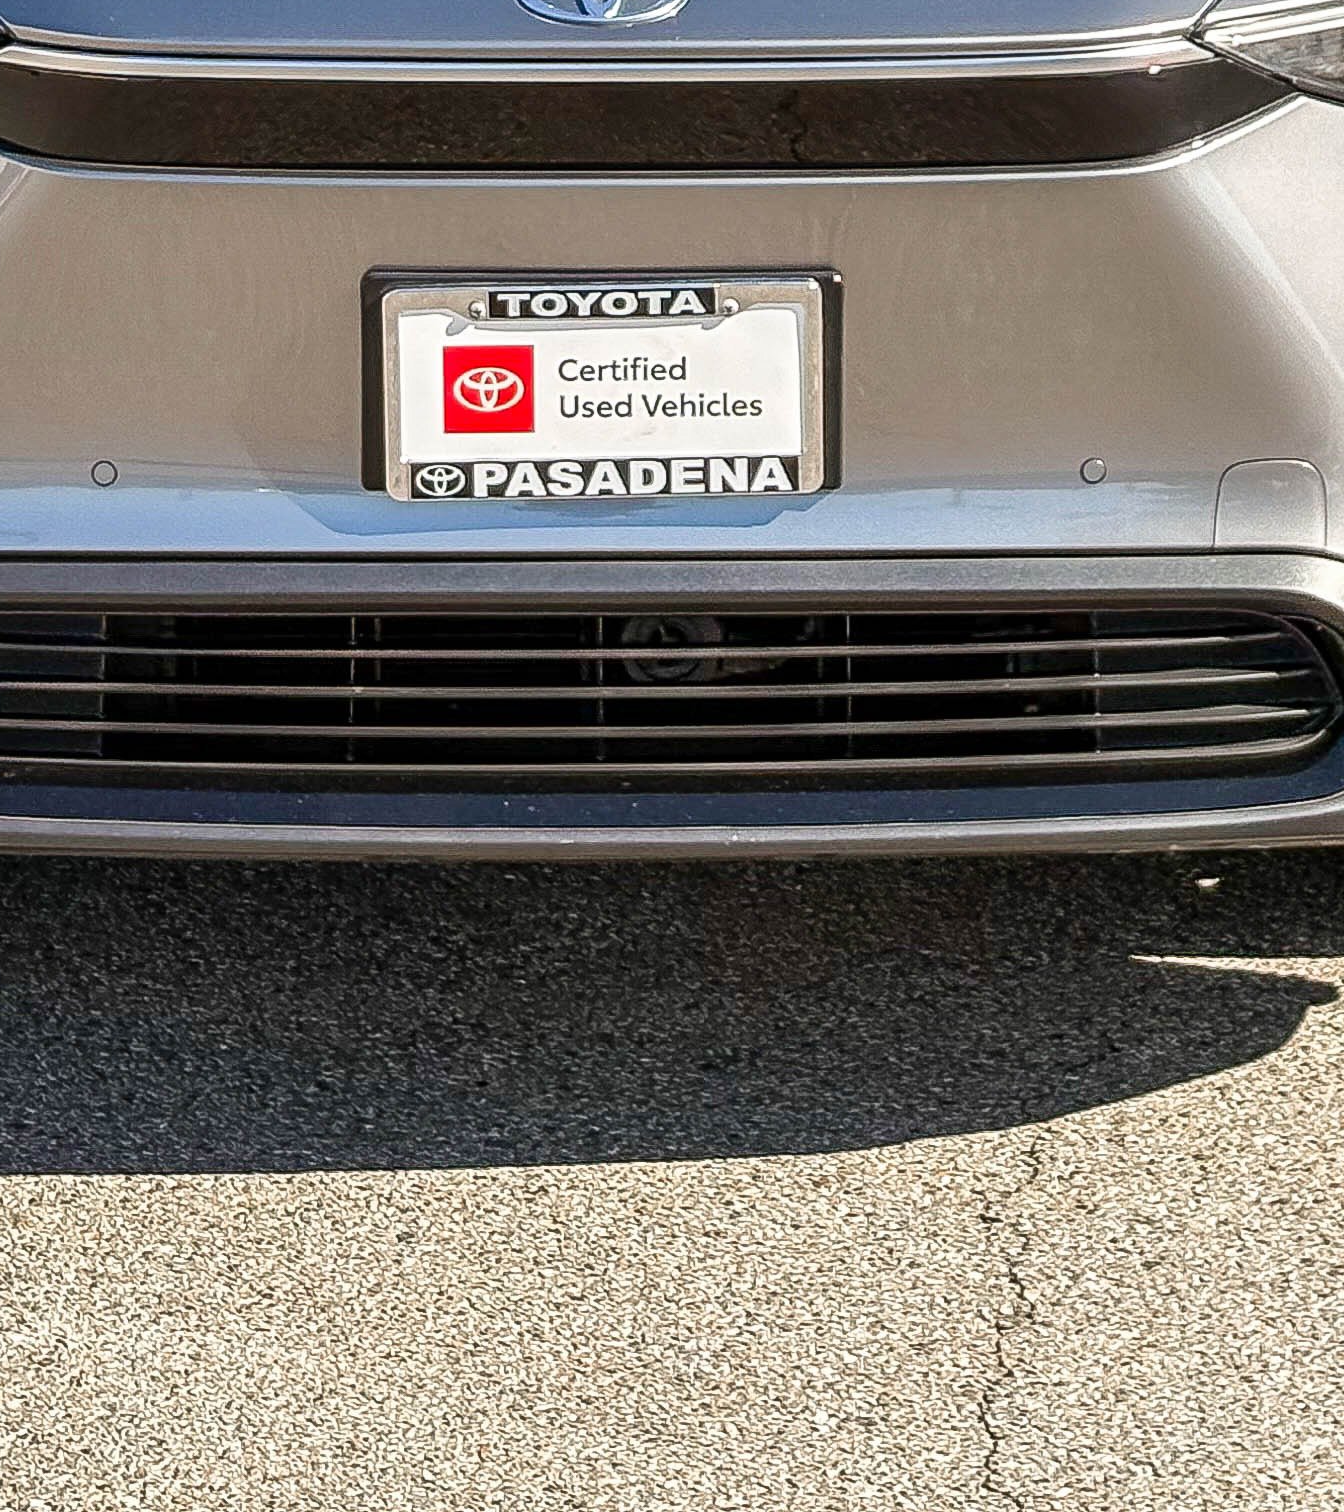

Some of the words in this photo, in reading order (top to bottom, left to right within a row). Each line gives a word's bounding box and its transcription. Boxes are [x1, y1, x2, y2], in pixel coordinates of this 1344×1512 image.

[497, 290, 707, 318] TOYOTA
[557, 355, 688, 382] Certified
[558, 393, 633, 419] Used
[641, 392, 764, 419] Vehicles
[472, 456, 796, 498] PASADENA
